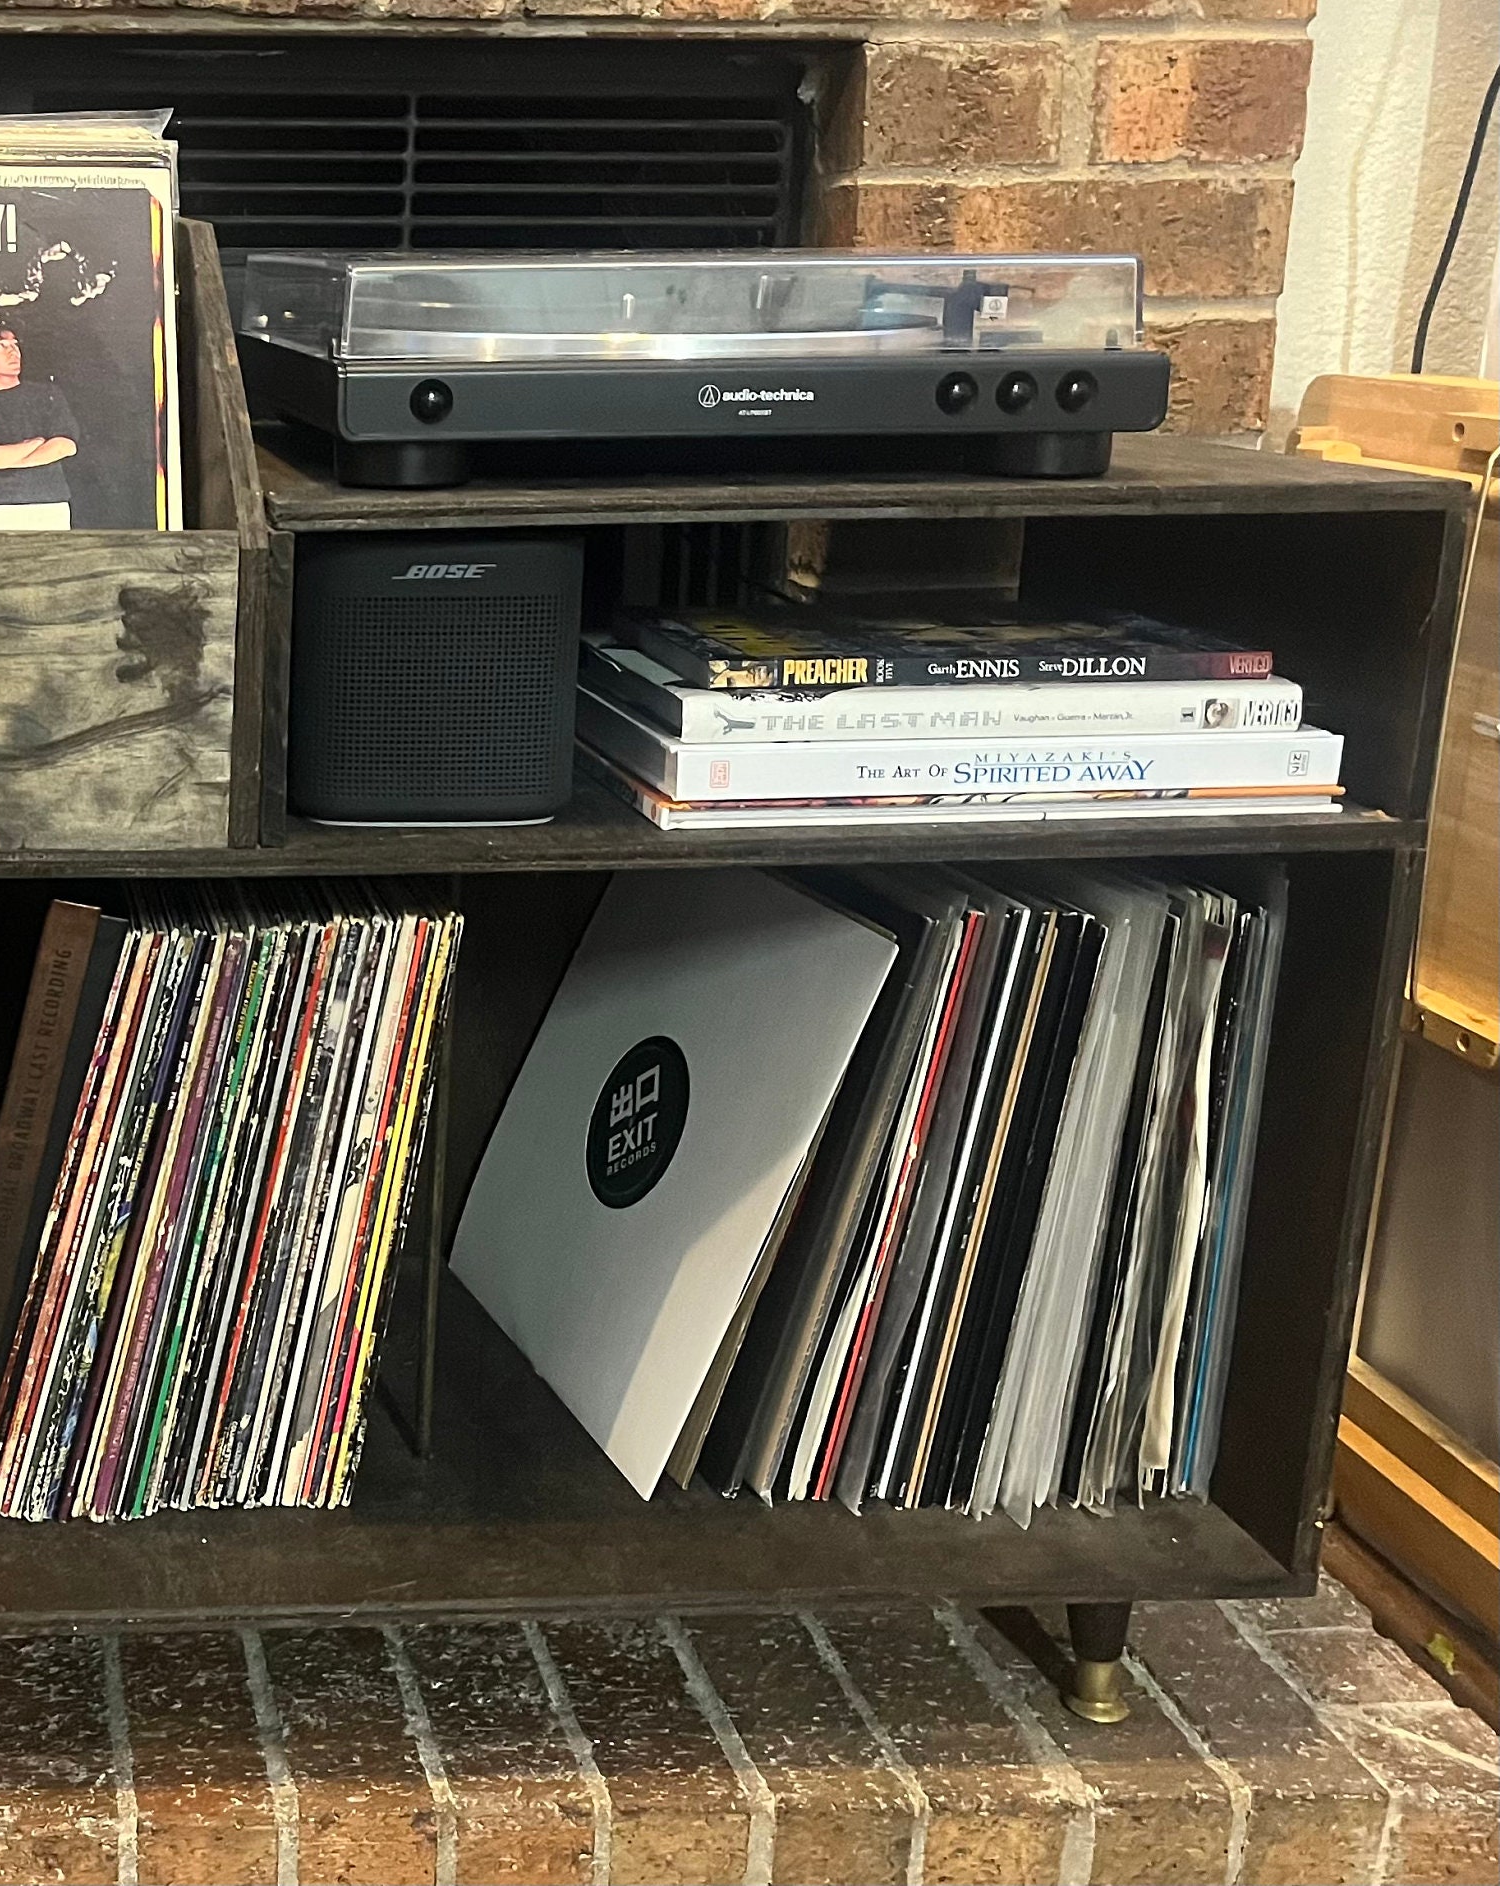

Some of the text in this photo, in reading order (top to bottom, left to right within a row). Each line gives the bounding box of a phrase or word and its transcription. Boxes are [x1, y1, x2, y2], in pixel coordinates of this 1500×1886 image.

[722, 389, 814, 401] audio-technica
[391, 563, 497, 579] BOSE
[783, 658, 868, 685] PREACHER
[876, 658, 885, 683] BOOK
[928, 659, 1020, 678] Garth ENNIS
[1039, 657, 1147, 676] Steve DILLON
[1229, 655, 1271, 674] VERTIGO
[761, 710, 1002, 731] THE LAST MAN
[1013, 713, 1050, 723] Vaughan
[1243, 700, 1300, 726] VERTIGO
[975, 751, 1132, 763] MIYAZAKI'S
[856, 760, 1155, 783] THE ART OF SPIRITED AWAY
[244, 960, 259, 998] ALLIGATOR
[36, 947, 72, 1038] RECORDING
[234, 1015, 246, 1043] STEREO
[26, 1042, 50, 1080] CAST
[310, 1045, 322, 1079] GREATEST
[218, 1086, 230, 1113] WINTER
[610, 1064, 660, 1128] 出口
[6, 1086, 40, 1171] BROADWAY
[607, 1112, 658, 1163] EXIT
[606, 1141, 657, 1176] RECORDS
